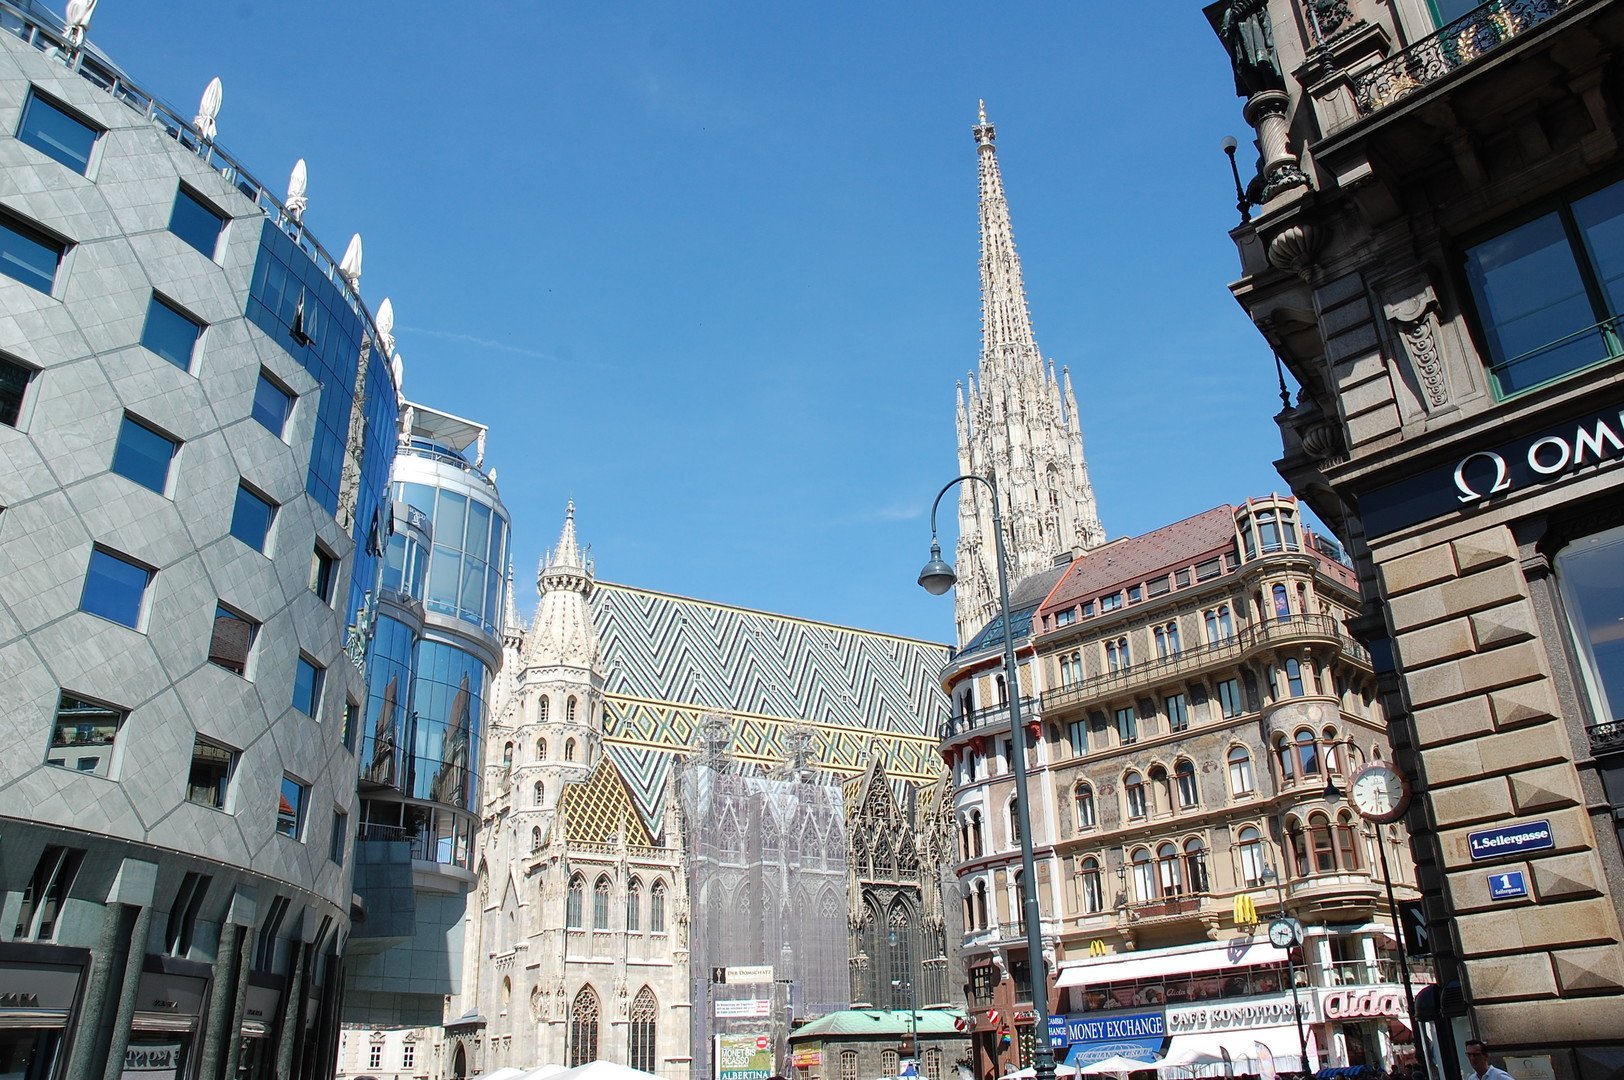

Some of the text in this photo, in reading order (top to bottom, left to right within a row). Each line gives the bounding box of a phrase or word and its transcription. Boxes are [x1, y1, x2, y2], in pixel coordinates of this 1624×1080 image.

[1527, 410, 1624, 475] OM
[1500, 874, 1512, 889] 1
[1211, 1001, 1309, 1022] KONDITORI
[1069, 1017, 1164, 1041] MONEY EXCHANGE
[721, 1048, 744, 1057] MONET
[721, 1057, 749, 1065] PICASSO
[722, 1070, 768, 1080] ALBERTINA
